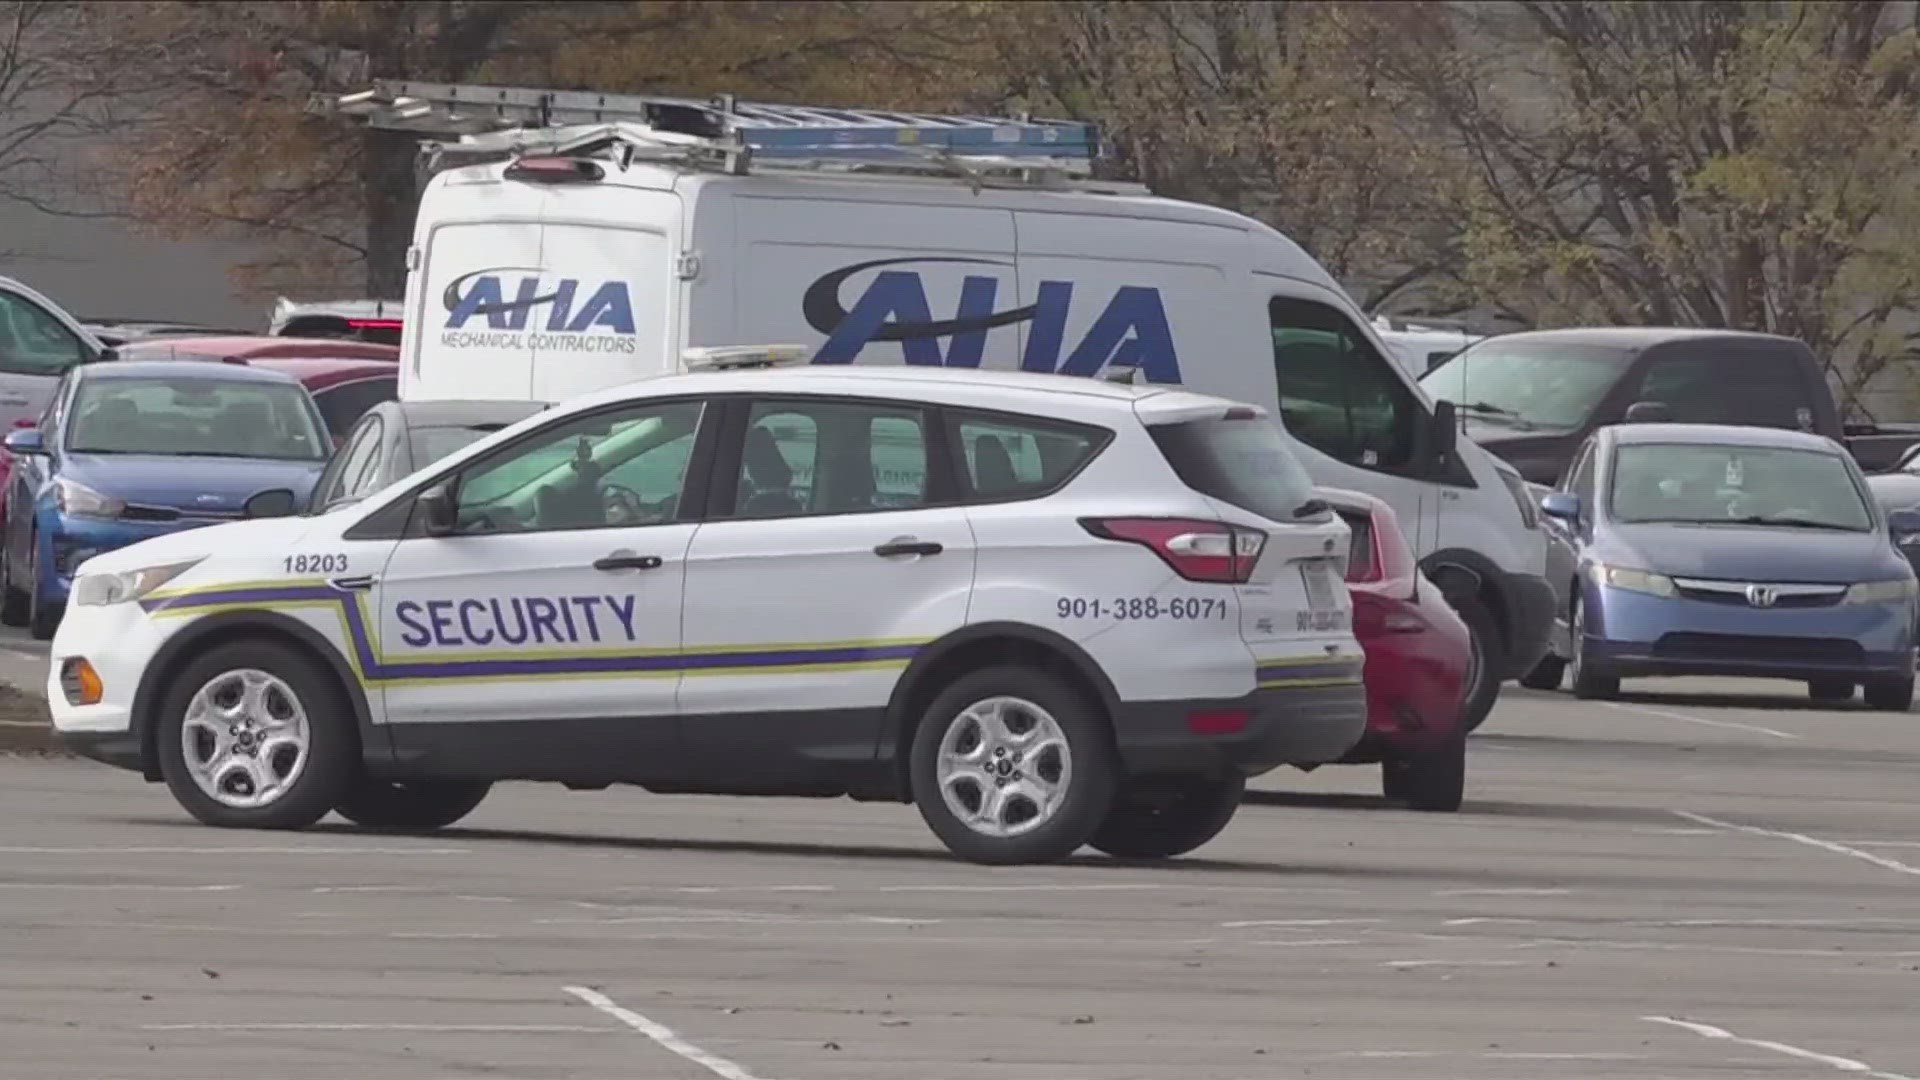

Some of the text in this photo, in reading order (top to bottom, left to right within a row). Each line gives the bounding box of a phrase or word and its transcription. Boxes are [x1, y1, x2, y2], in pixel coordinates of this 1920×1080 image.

[444, 276, 636, 334] AHA
[441, 331, 636, 354] MECHANICAL CONTRACTORS
[808, 271, 1183, 384] AHA
[283, 553, 348, 573] 18203
[396, 595, 637, 648] SECURITY
[1056, 597, 1227, 621] 901-388-6071
